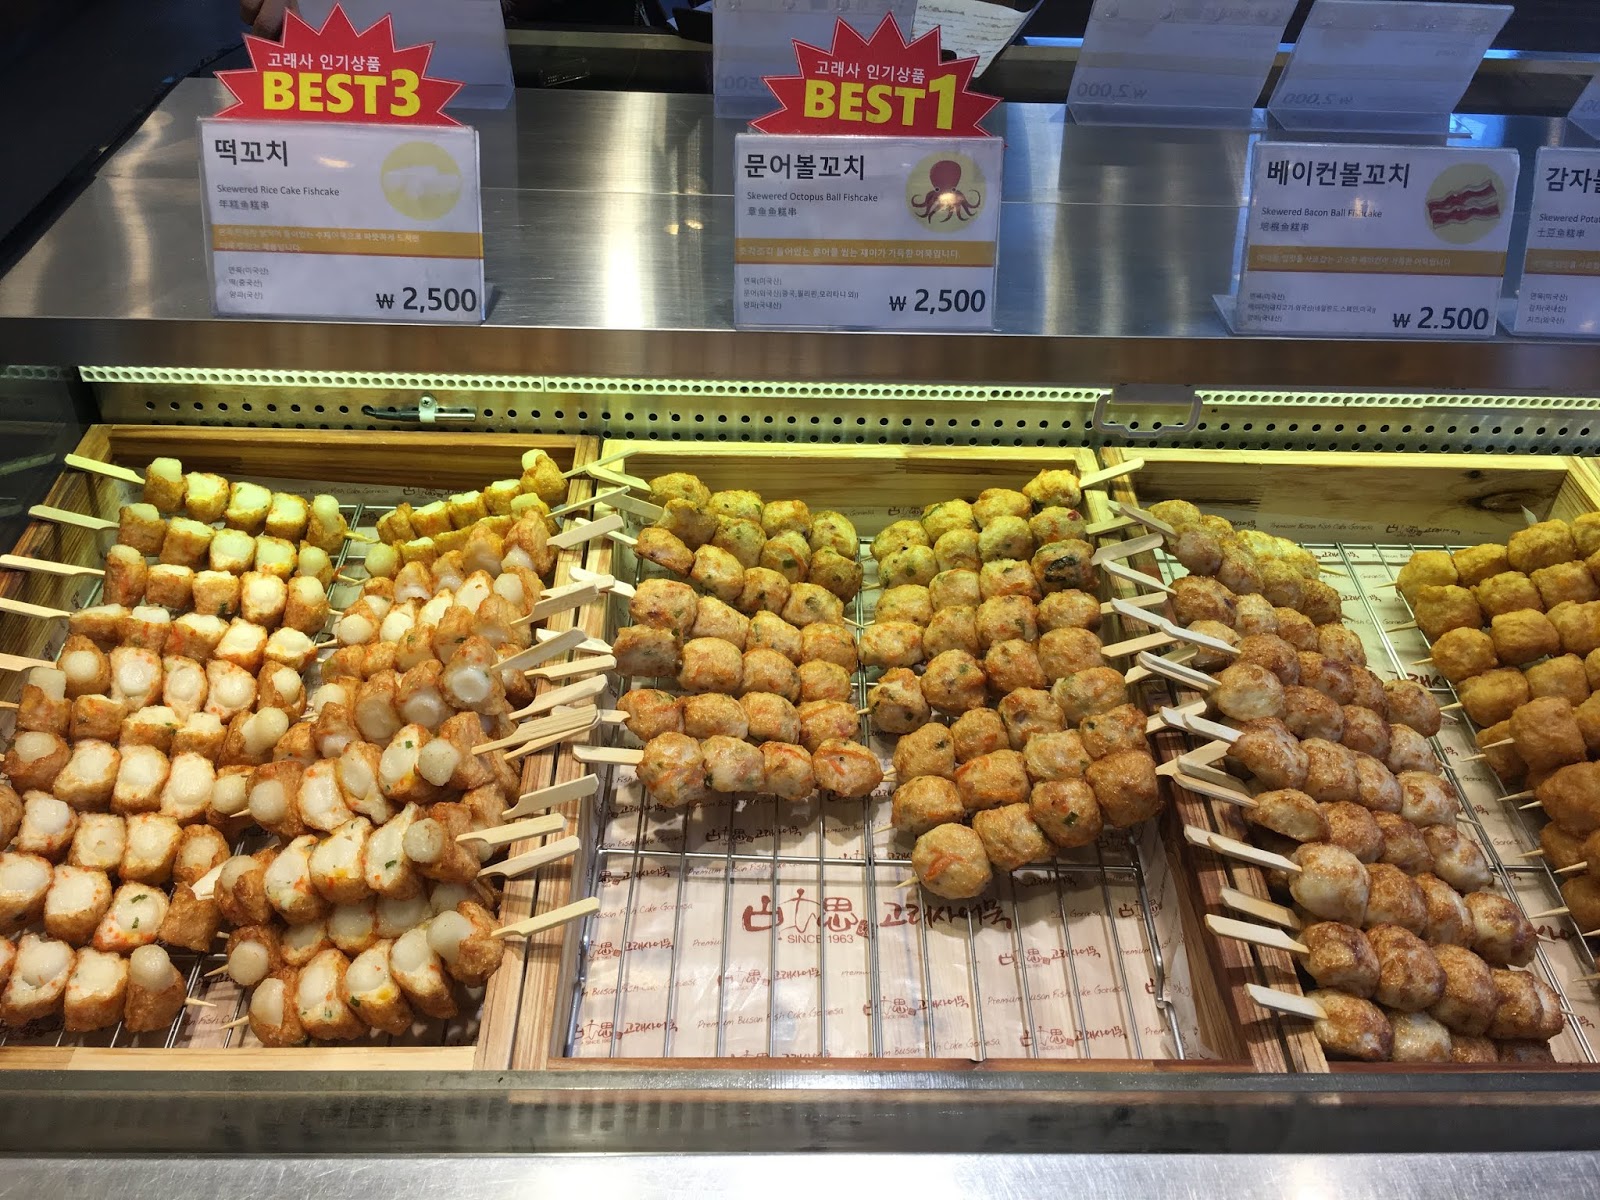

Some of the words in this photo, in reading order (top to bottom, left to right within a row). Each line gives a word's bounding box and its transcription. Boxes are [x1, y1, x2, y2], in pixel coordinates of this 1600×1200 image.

[268, 52, 313, 69] 고래사
[320, 54, 381, 72] 인기상품
[815, 60, 860, 78] 고래사
[866, 64, 925, 84] 인기상품
[263, 69, 421, 117] BEST3
[803, 74, 957, 130] BEST1
[215, 139, 289, 167] 떡꼬치
[744, 154, 864, 181] 문어볼꼬치
[1267, 160, 1410, 188] 베이컨볼꼬치
[216, 184, 258, 194] Skewered
[260, 185, 278, 195] Rice
[280, 186, 300, 196] Cake
[303, 186, 340, 196] Fishcake
[747, 191, 788, 201] Skewered
[789, 192, 824, 203] Octopus
[826, 193, 841, 202] Ball
[843, 193, 878, 203] Fishcake
[1261, 206, 1302, 216] Skewered
[1304, 207, 1328, 217] Bacon
[1330, 208, 1346, 217] Ball
[1539, 213, 1578, 223] Skewered
[402, 287, 477, 313] 2,500
[914, 289, 986, 315] 2,500
[787, 934, 822, 944] SINCE
[828, 934, 854, 944] 1963
